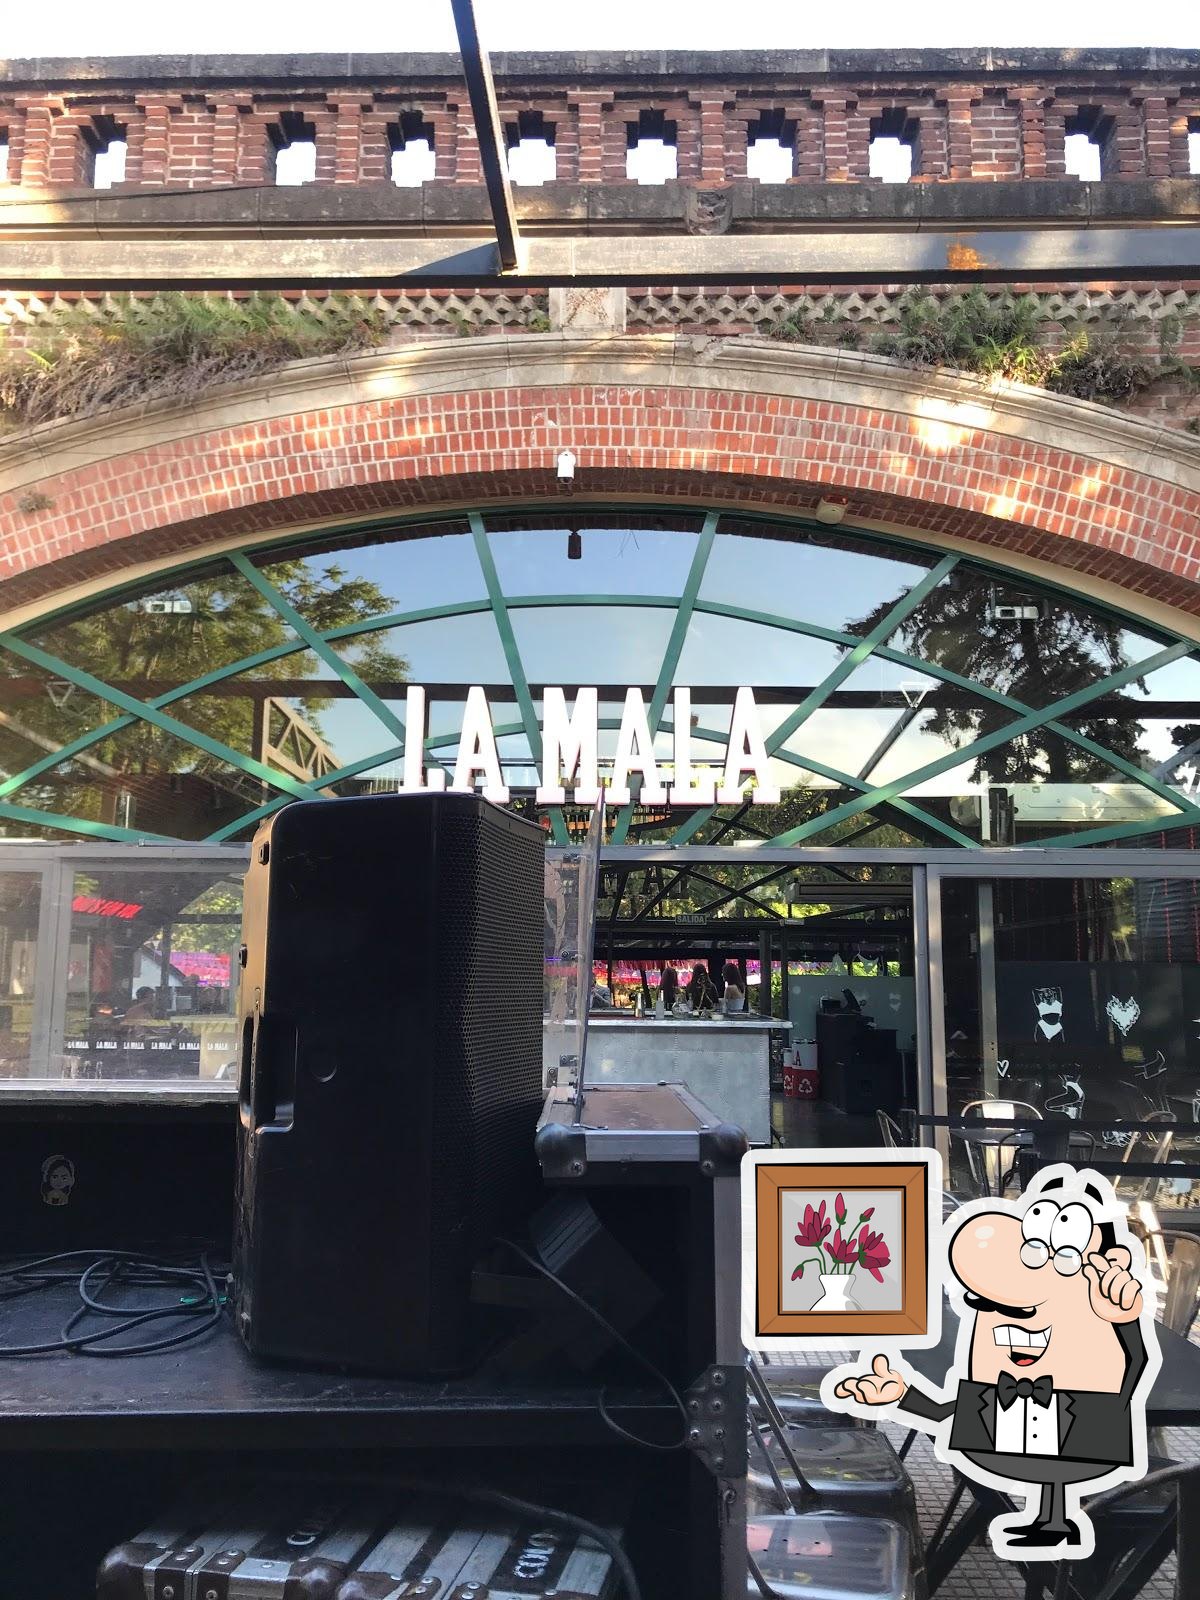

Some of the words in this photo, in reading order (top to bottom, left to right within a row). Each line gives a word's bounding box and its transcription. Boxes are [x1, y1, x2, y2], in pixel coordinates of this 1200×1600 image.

[400, 685, 510, 804] LA
[536, 686, 781, 805] MALA
[676, 915, 705, 924] SALIDA
